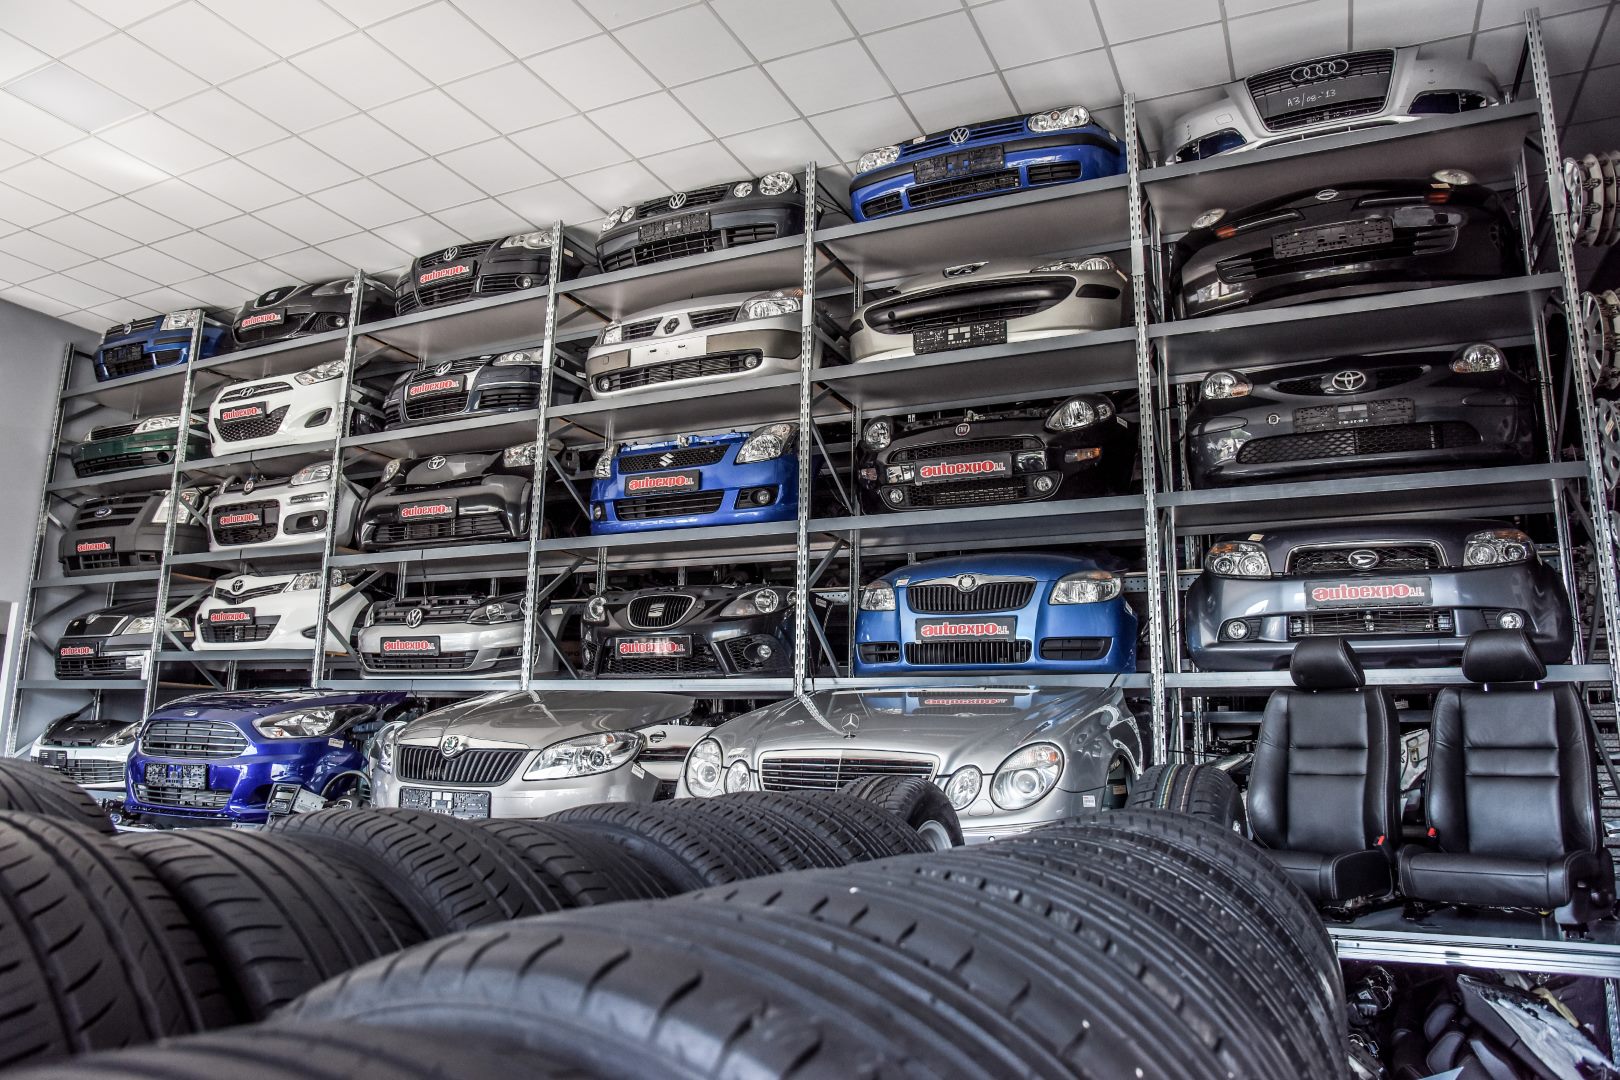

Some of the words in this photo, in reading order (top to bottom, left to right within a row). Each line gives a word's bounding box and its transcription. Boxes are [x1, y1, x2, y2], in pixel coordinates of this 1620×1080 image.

[921, 460, 994, 478] autoexpo
[1312, 584, 1410, 601] autoexpo
[921, 622, 998, 637] autoexpo
